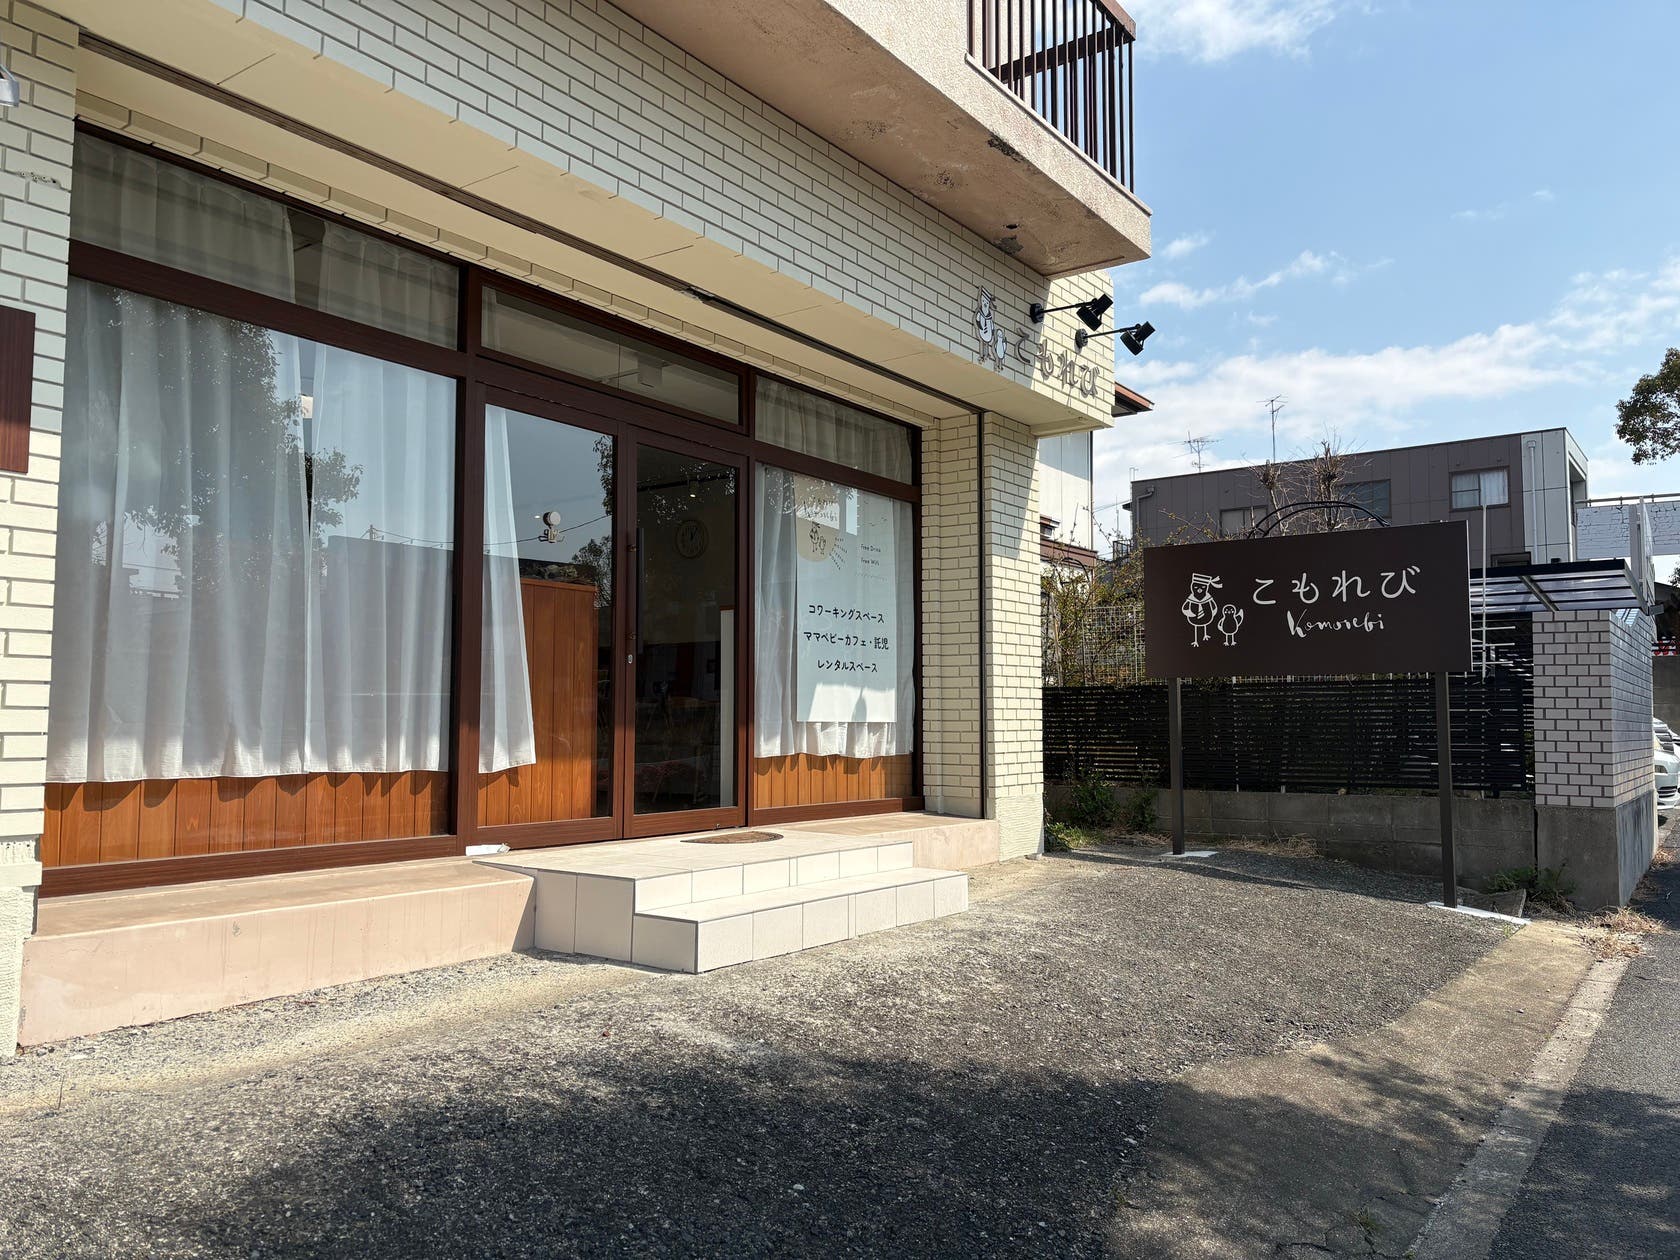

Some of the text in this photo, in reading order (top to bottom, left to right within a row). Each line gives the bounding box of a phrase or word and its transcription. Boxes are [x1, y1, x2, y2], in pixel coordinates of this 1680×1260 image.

[1014, 327, 1100, 398] こもれび
[1253, 565, 1421, 605] こもれび
[1287, 609, 1385, 638] Komorebi
